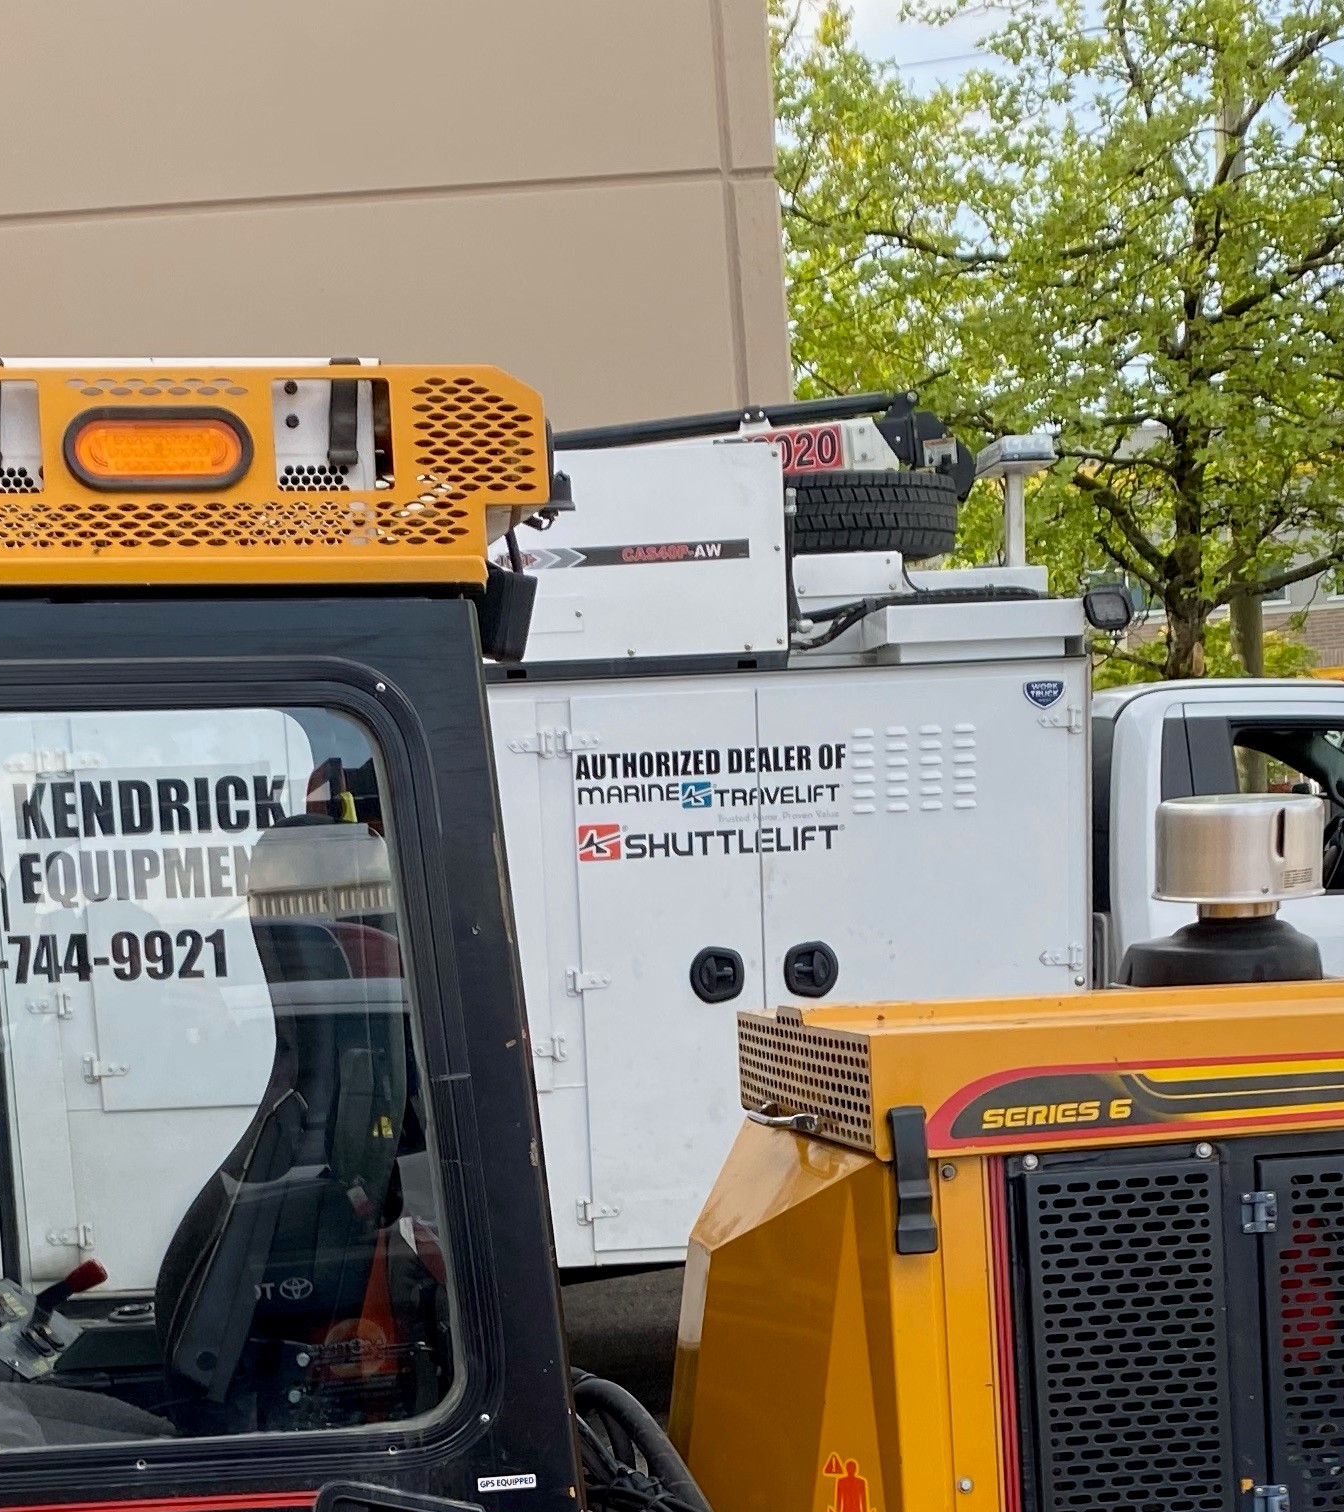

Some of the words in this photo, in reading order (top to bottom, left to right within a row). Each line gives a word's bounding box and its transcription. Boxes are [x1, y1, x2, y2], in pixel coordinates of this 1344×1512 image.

[753, 428, 837, 470] 020
[1030, 689, 1059, 697] TRUCK
[1031, 682, 1058, 690] WORK
[575, 749, 721, 781] AUTHORIZED
[727, 744, 812, 775] DEALER
[818, 743, 847, 770] OF
[12, 774, 287, 841] KENDRICK
[577, 782, 680, 806] MARINE
[713, 783, 841, 807] TRAVELIFT
[625, 824, 839, 860] SHUTTLELIFT
[981, 1100, 1102, 1130] SERIES
[1109, 1098, 1133, 1120] 6
[479, 1479, 495, 1489] GPS
[496, 1476, 535, 1487] EQUIPPED
